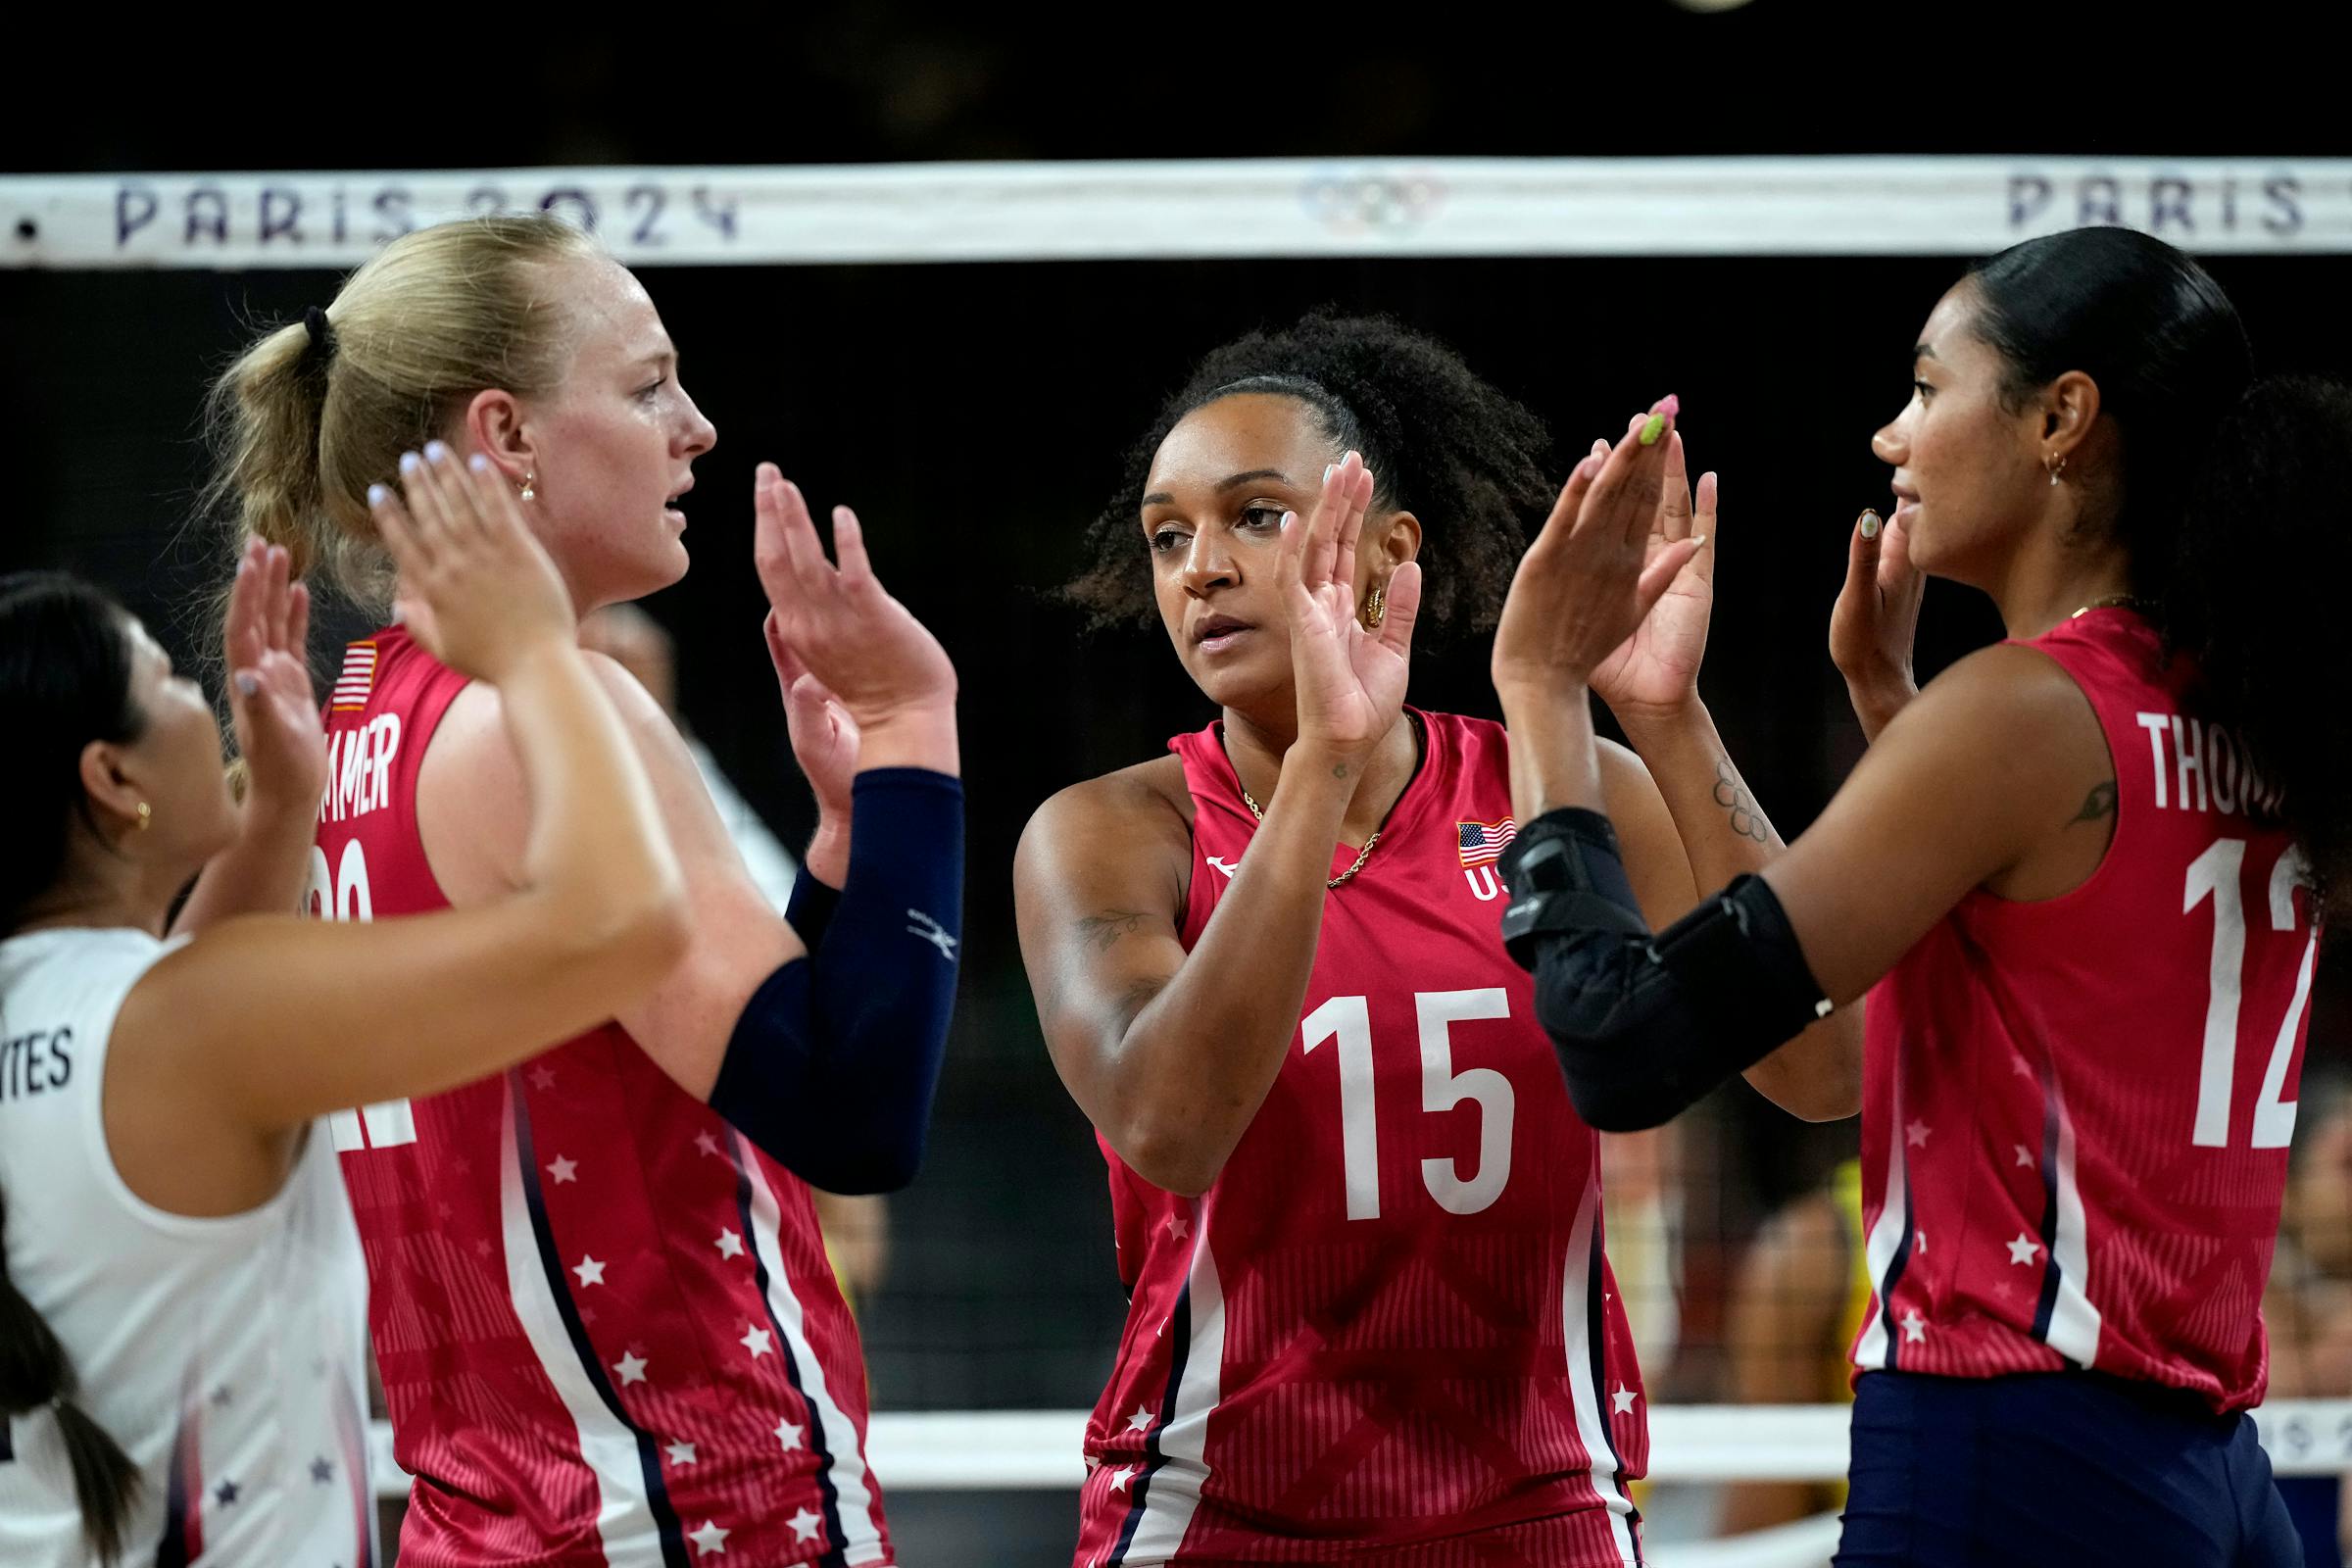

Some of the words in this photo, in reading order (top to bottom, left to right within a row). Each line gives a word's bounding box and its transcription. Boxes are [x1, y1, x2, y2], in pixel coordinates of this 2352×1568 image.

[2136, 711, 2289, 820] THOM
[1301, 987, 1515, 1221] 15
[2182, 837, 2321, 1149] 12
